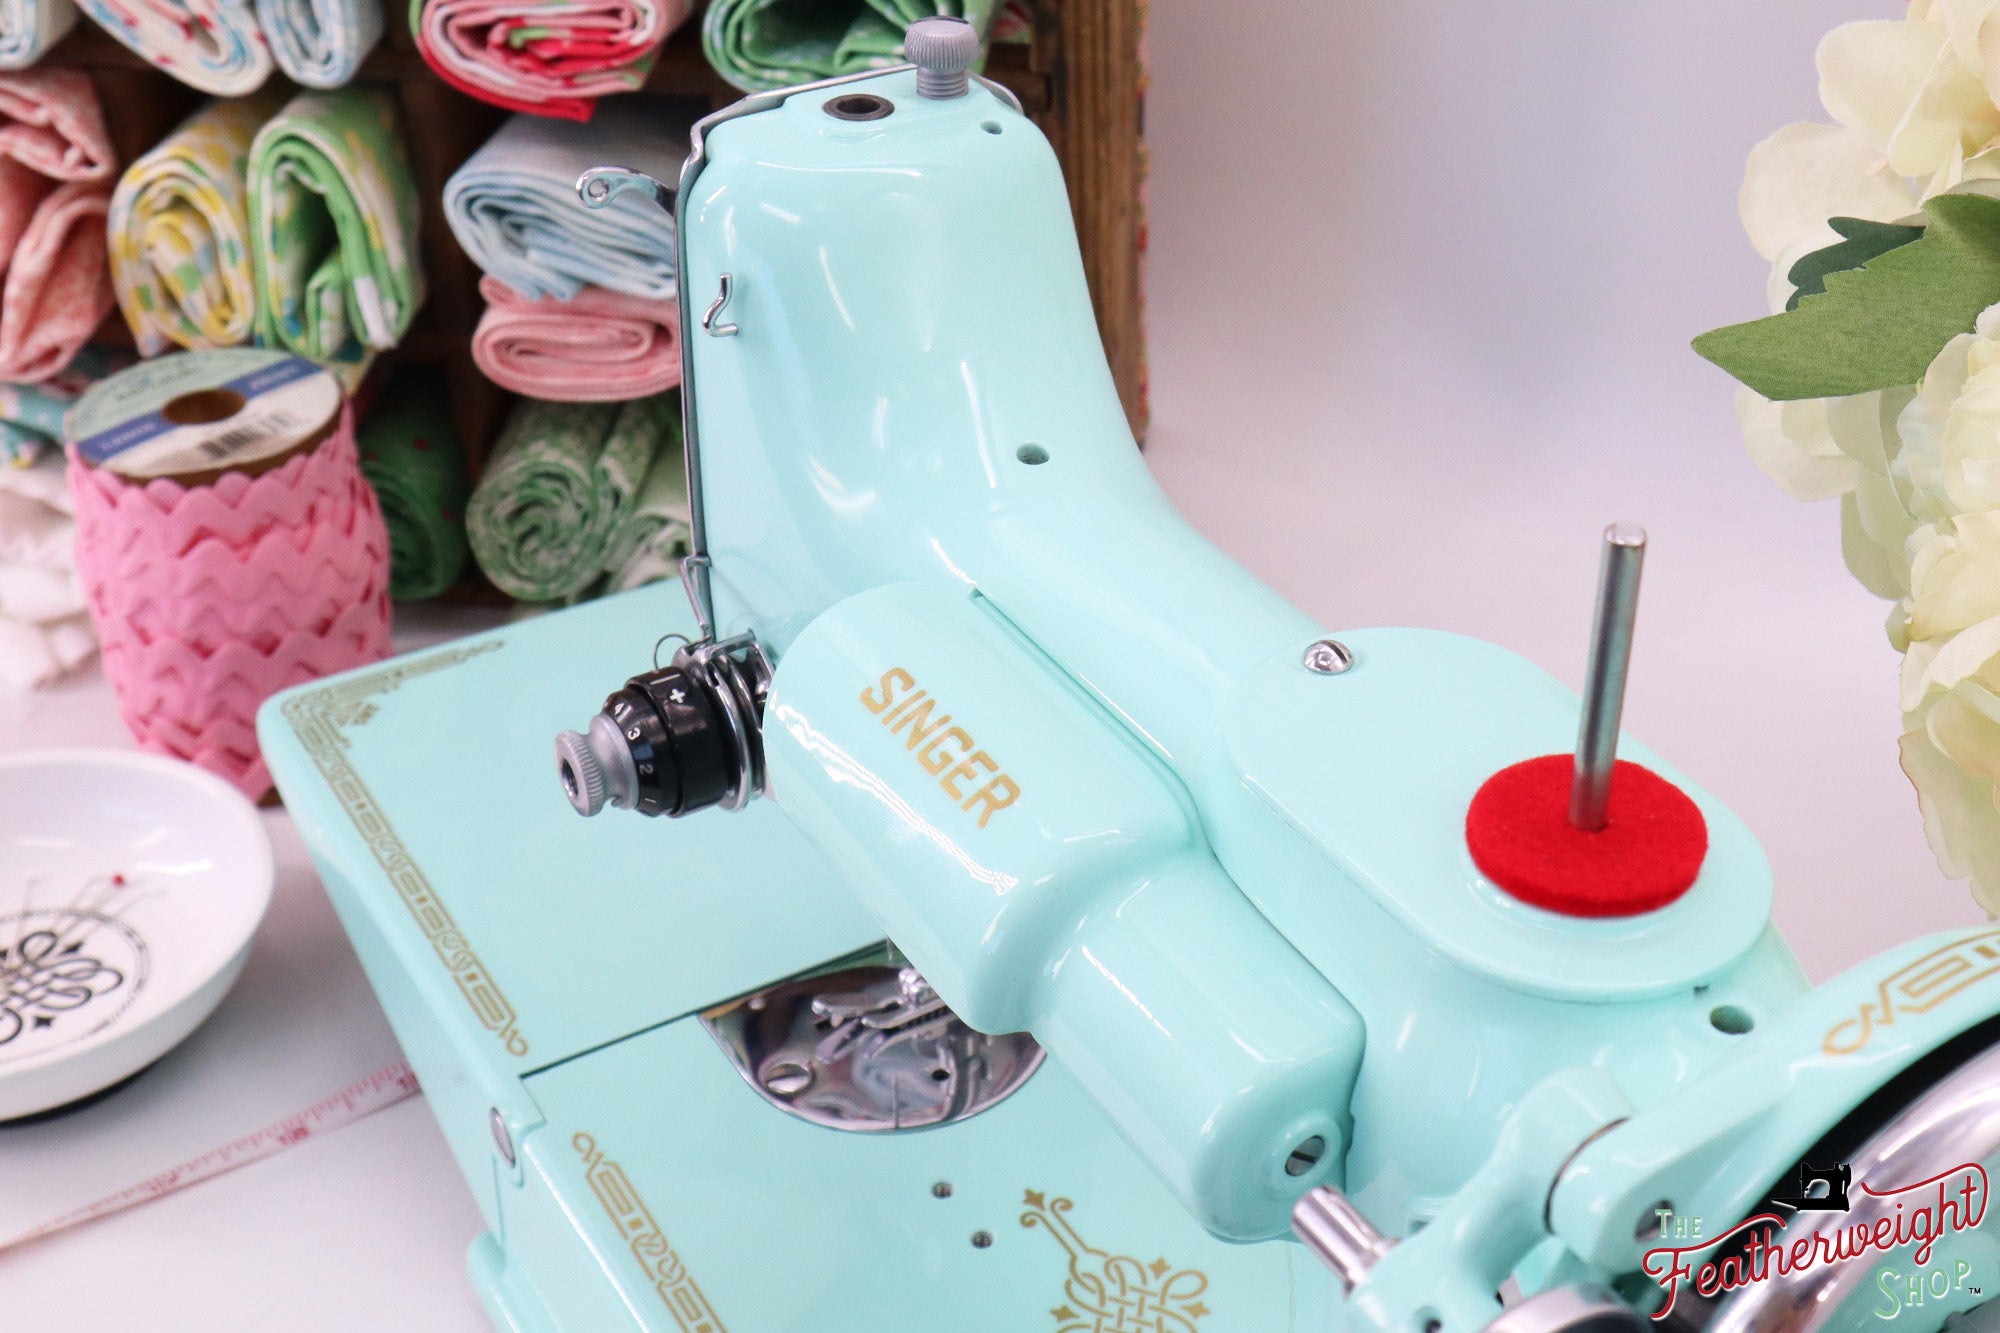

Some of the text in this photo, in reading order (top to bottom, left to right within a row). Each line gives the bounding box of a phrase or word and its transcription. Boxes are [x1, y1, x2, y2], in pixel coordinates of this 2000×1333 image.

[627, 727, 641, 741] 3
[860, 667, 1021, 828] SINGER
[639, 764, 654, 775] 2
